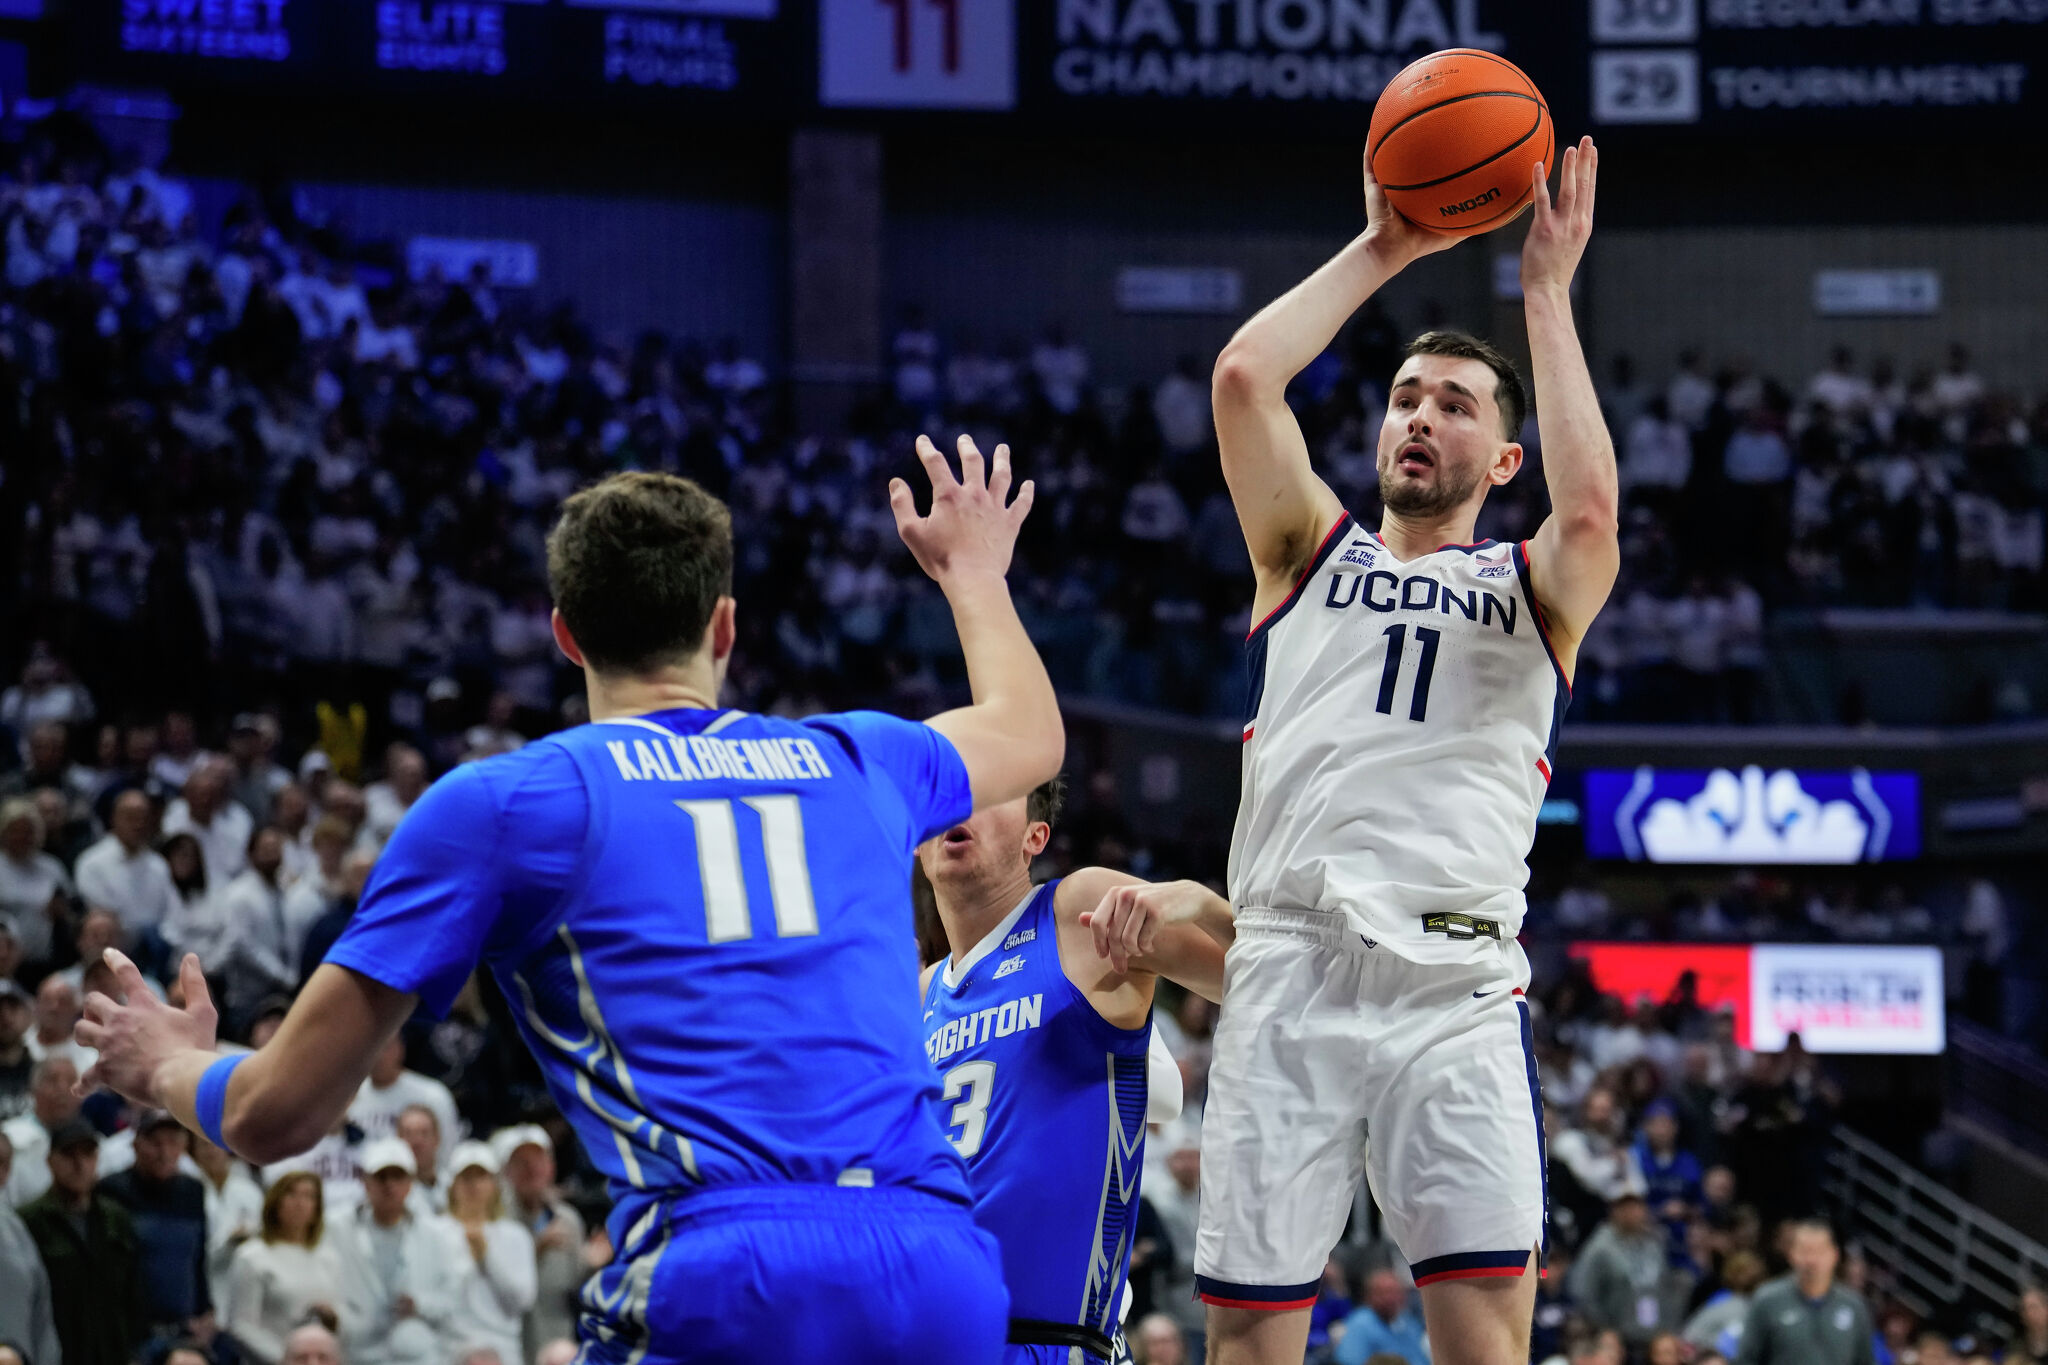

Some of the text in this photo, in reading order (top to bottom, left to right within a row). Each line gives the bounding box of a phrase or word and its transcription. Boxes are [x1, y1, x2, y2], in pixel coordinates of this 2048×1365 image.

[1055, 0, 1504, 48] NATIONAL
[1053, 48, 1380, 99] CHAMPIONS
[1711, 64, 2026, 108] TOURNAMENT
[1439, 187, 1501, 217] UCONN
[1339, 554, 1375, 569] CHANGE
[1360, 550, 1376, 562] THE
[1475, 569, 1513, 578] EAST
[1480, 565, 1506, 573] BIG
[1325, 570, 1516, 636] UCONN
[1375, 623, 1441, 722] 11
[605, 735, 832, 782] KALKBRENNER
[672, 793, 819, 945] 11
[1004, 931, 1037, 951] CHANGE
[1477, 923, 1490, 932] 48
[925, 993, 1043, 1064] EIGHTON
